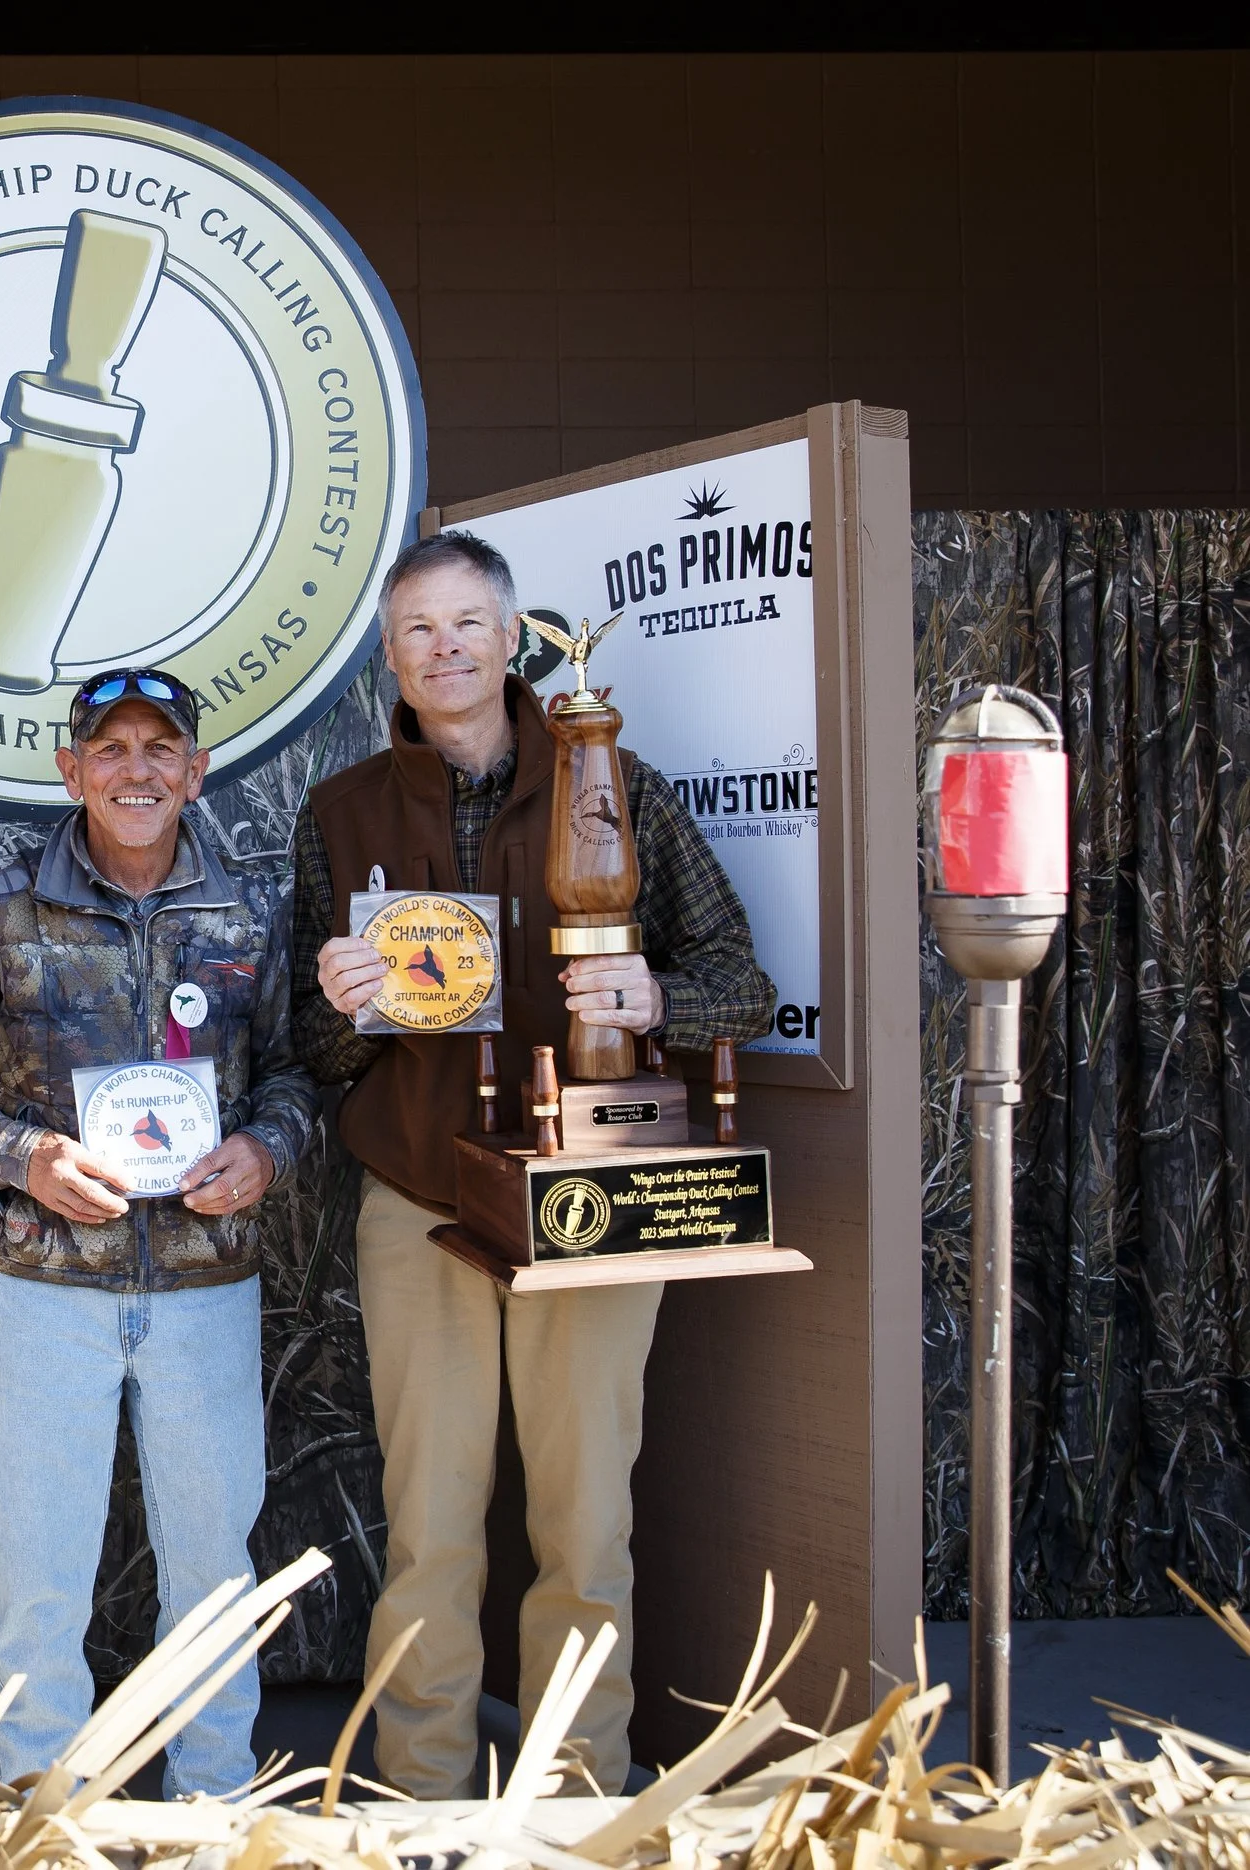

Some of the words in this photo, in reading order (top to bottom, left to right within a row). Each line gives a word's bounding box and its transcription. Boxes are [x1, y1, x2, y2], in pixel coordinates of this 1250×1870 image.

[74, 164, 191, 219] DUCK
[200, 208, 332, 352] CALLING
[312, 367, 359, 566] CONTEST
[604, 543, 667, 612] DOS
[680, 521, 813, 589] PRIMOS
[639, 594, 781, 638] TEQUILA
[197, 608, 307, 721] ANSAS
[571, 789, 589, 809] WORLD
[570, 821, 584, 839] DUCK
[583, 836, 615, 846] CALLING
[727, 822, 761, 838] Bourbon
[765, 820, 802, 838] Whiskey
[381, 899, 429, 924] WORLD'S
[433, 900, 491, 962] CHAMPIONSHIP
[390, 926, 463, 942] CHAMPION
[457, 956, 474, 969] 23
[374, 992, 394, 1010] UCK
[393, 1008, 441, 1026] CALLING
[444, 982, 488, 1022] CONTEST
[395, 992, 446, 1002] STUTTGART,
[448, 993, 461, 1001] AR
[88, 1092, 106, 1131] SENIOR
[102, 1068, 148, 1093] WORLD'S
[151, 1068, 211, 1124] CHAMPIONSHIP
[110, 1099, 124, 1109] 1st
[127, 1094, 188, 1108] RUNNER-UP
[605, 1105, 636, 1114] Sponsored
[106, 1123, 122, 1137] 20
[180, 1118, 196, 1131] 23
[123, 1155, 173, 1167] STUTTGART,
[175, 1155, 187, 1163] AR
[656, 1173, 672, 1185] Over
[674, 1169, 685, 1182] the
[686, 1169, 709, 1181] Prairie
[613, 1192, 640, 1206] World's
[641, 1187, 687, 1205] Championship
[688, 1187, 709, 1200] Duck
[709, 1184, 733, 1200] Calling
[734, 1184, 759, 1196] Contest
[654, 1207, 687, 1223] Stuttgart,
[688, 1204, 720, 1219] Arkansas
[640, 1228, 656, 1239] 2023
[658, 1226, 679, 1239] Senior
[680, 1221, 701, 1236] World
[703, 1220, 736, 1236] Champion
